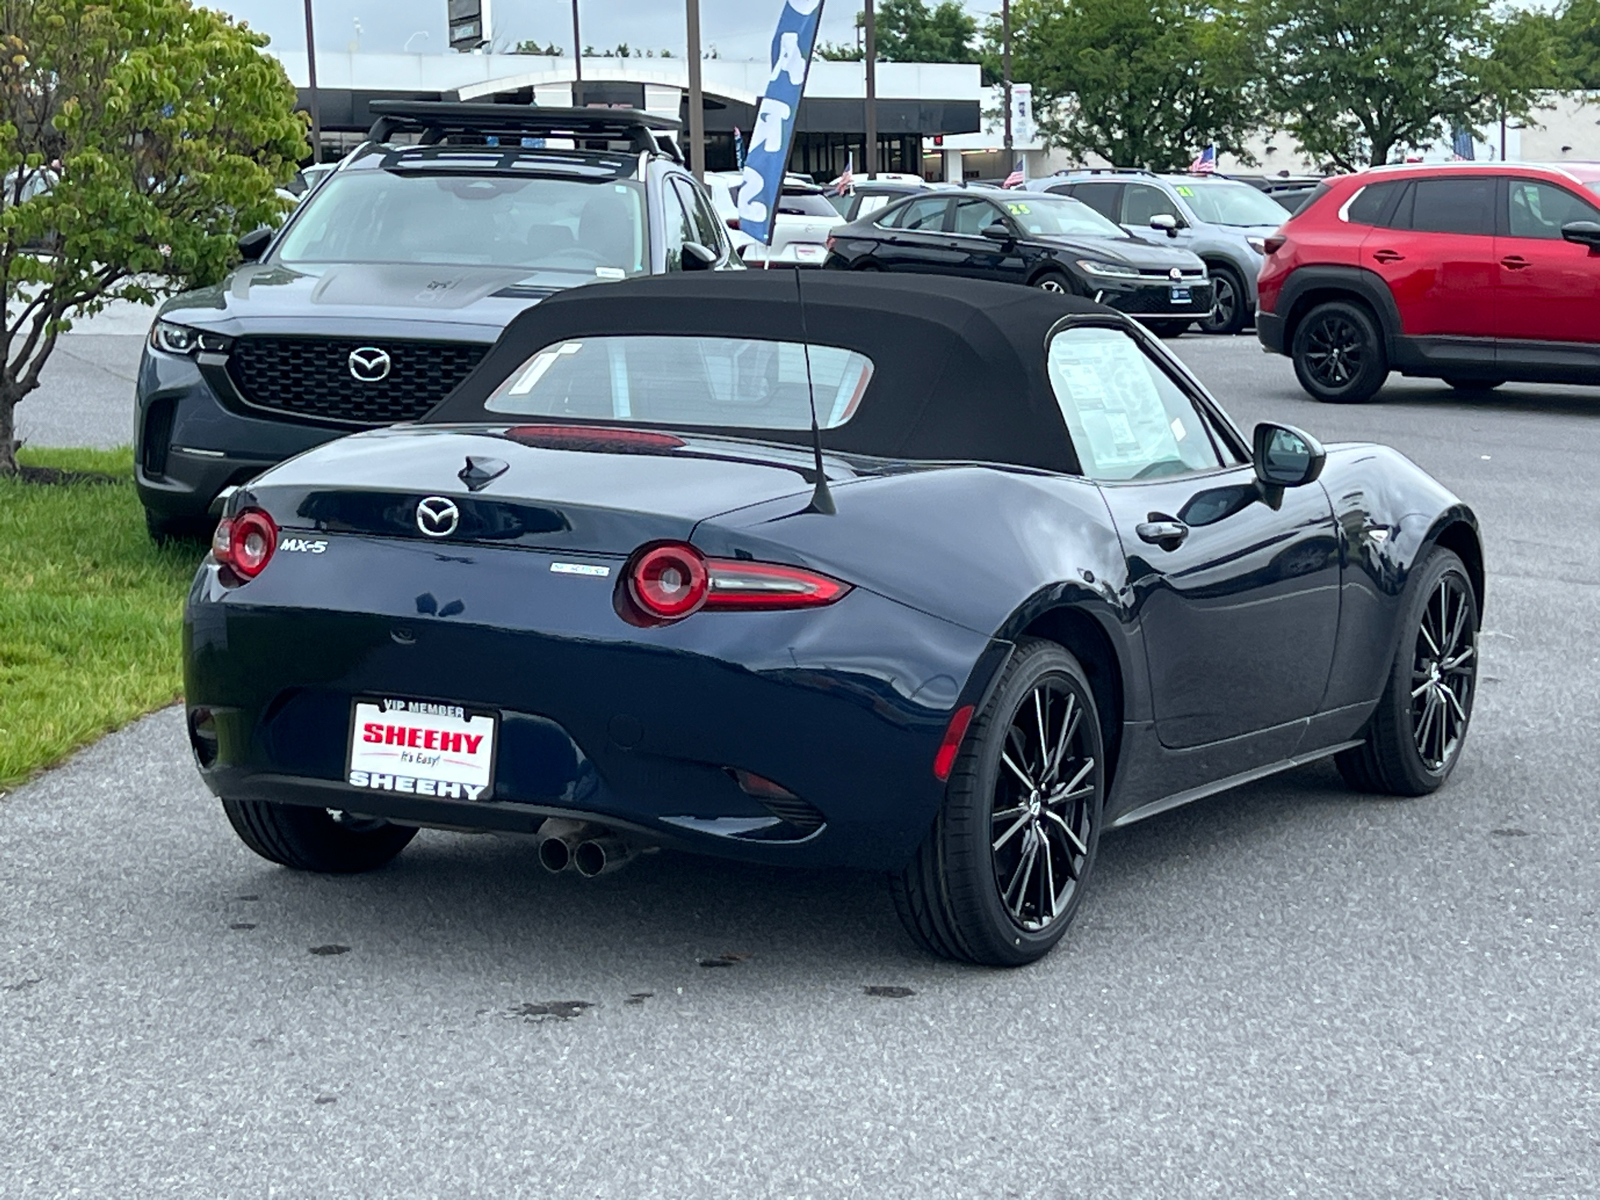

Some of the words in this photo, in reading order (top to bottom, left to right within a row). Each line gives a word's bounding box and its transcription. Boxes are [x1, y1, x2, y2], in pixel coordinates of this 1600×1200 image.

[279, 538, 329, 554] MX-5
[383, 698, 405, 712] VIP
[408, 701, 465, 719] MEMBER
[363, 722, 484, 755] SHEEHY
[400, 751, 414, 764] It's
[349, 771, 486, 801] SHEEHY
